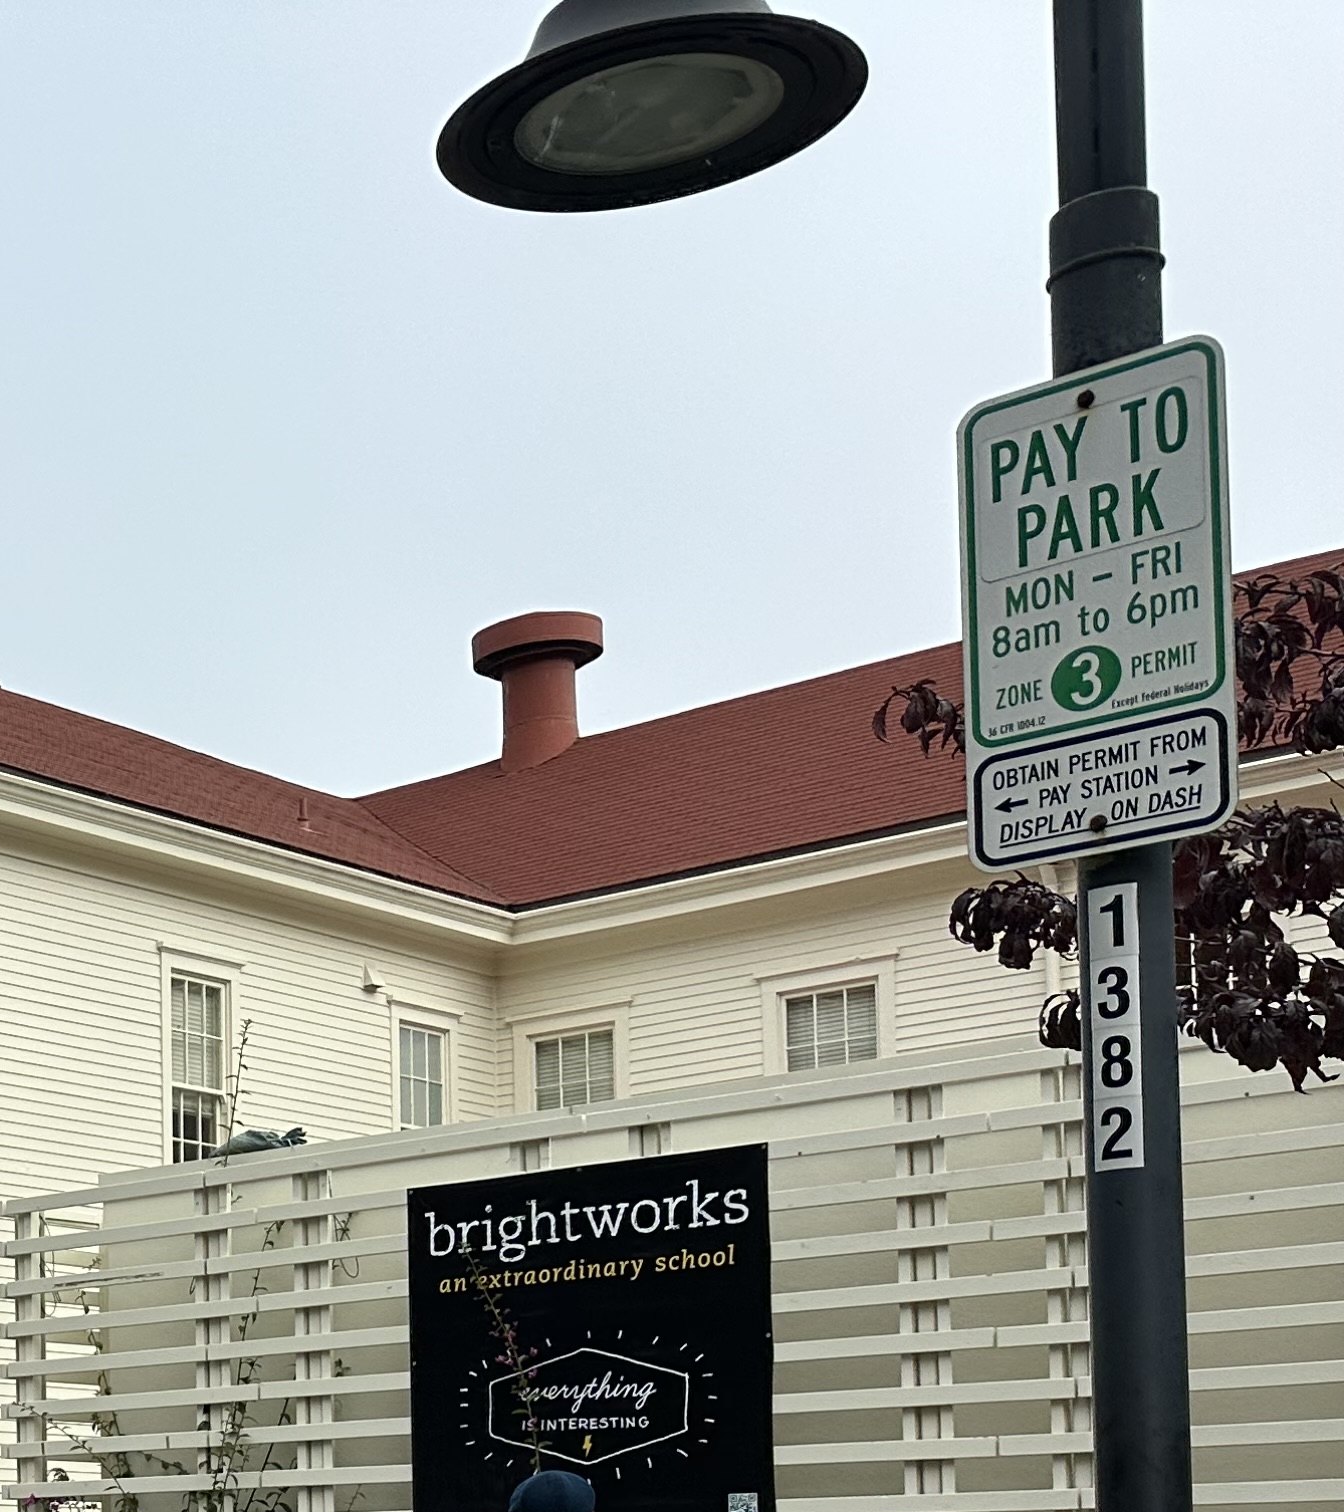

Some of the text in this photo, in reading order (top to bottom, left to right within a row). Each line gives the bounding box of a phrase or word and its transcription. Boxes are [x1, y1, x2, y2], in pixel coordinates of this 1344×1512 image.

[990, 386, 1189, 504] PAY TO
[1017, 468, 1165, 568] PARK
[1005, 569, 1075, 618] MON
[1131, 541, 1182, 585] FRI
[992, 583, 1199, 658] 8am to 6pm
[995, 641, 1199, 710] ZONE 3 PERMIT
[1111, 679, 1210, 709] Except Federal Holidays
[992, 725, 1207, 791] OBTAIN PERMIT FROM
[1000, 722, 1015, 735] CFR
[999, 783, 1203, 844] DISPLAY ON DASH
[1038, 764, 1159, 809] PAY STATION
[1097, 893, 1137, 1162] 1382
[424, 1179, 750, 1263] brightworks
[439, 1245, 736, 1294] an extraordinary school
[519, 1370, 657, 1414] everything
[521, 1416, 650, 1432] IS INTERESTING
